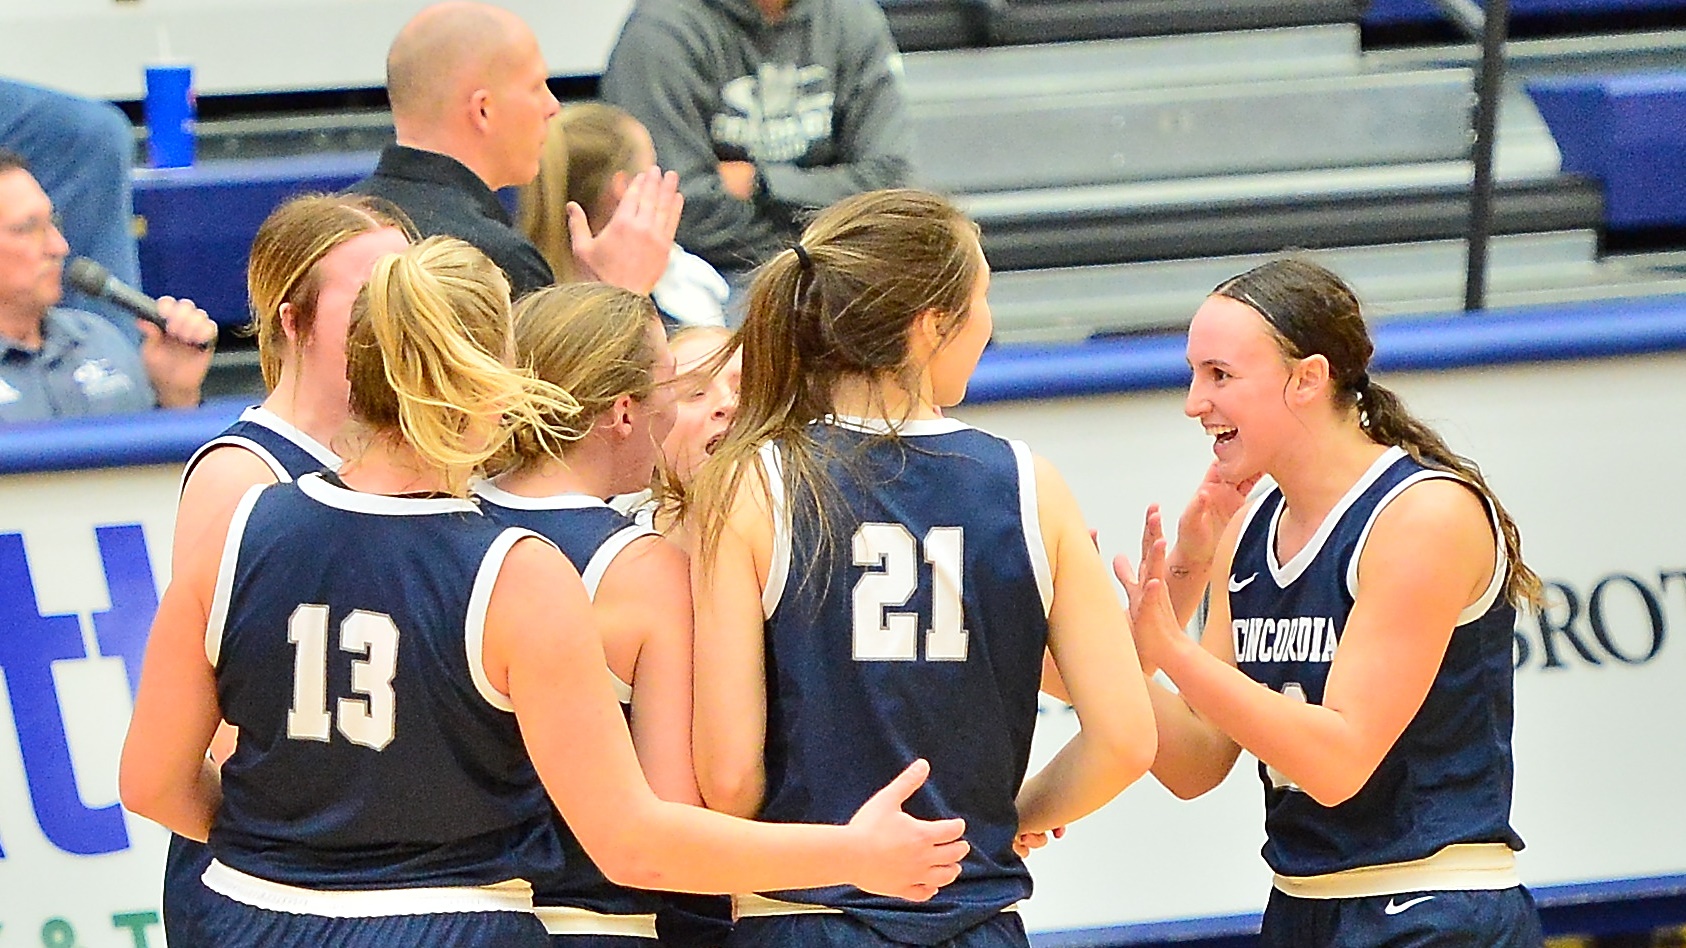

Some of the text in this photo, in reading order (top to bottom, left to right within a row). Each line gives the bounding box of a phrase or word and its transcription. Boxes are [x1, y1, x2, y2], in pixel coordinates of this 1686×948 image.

[851, 521, 969, 663] 21
[1515, 570, 1686, 670] RO
[0, 524, 158, 858] tt
[286, 603, 400, 752] 13
